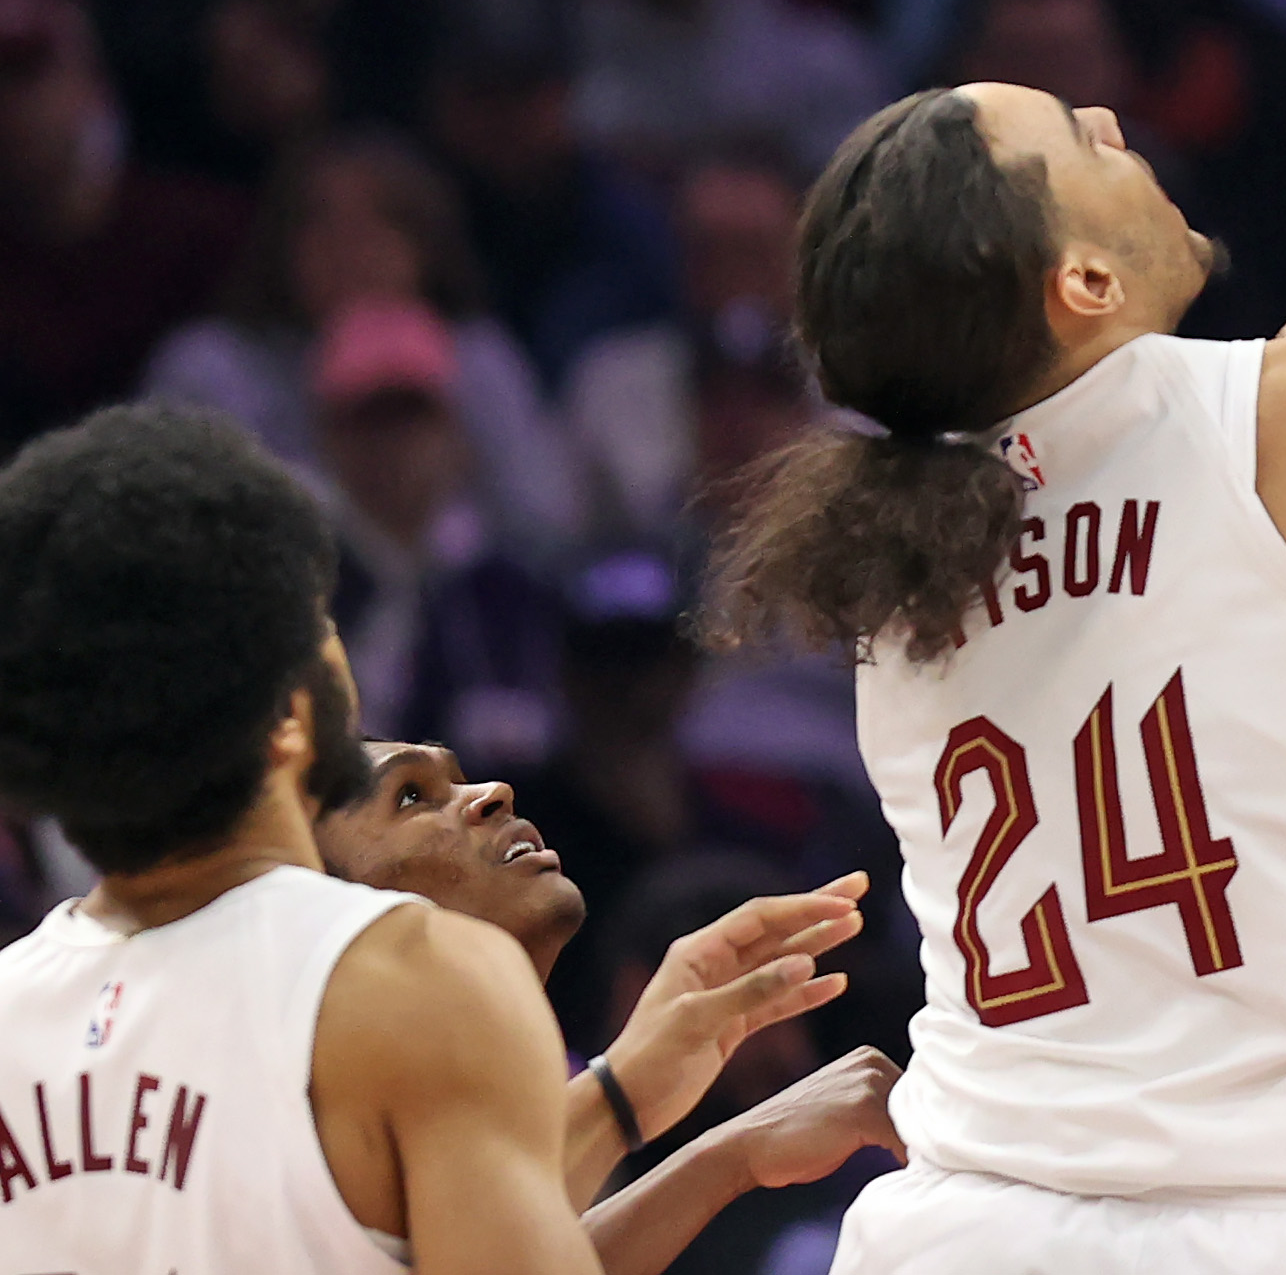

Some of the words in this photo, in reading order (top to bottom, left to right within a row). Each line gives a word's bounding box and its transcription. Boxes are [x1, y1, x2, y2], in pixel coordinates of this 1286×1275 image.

[952, 499, 1160, 649] SON
[934, 666, 1244, 1029] 24
[0, 1072, 208, 1204] ALLEN
